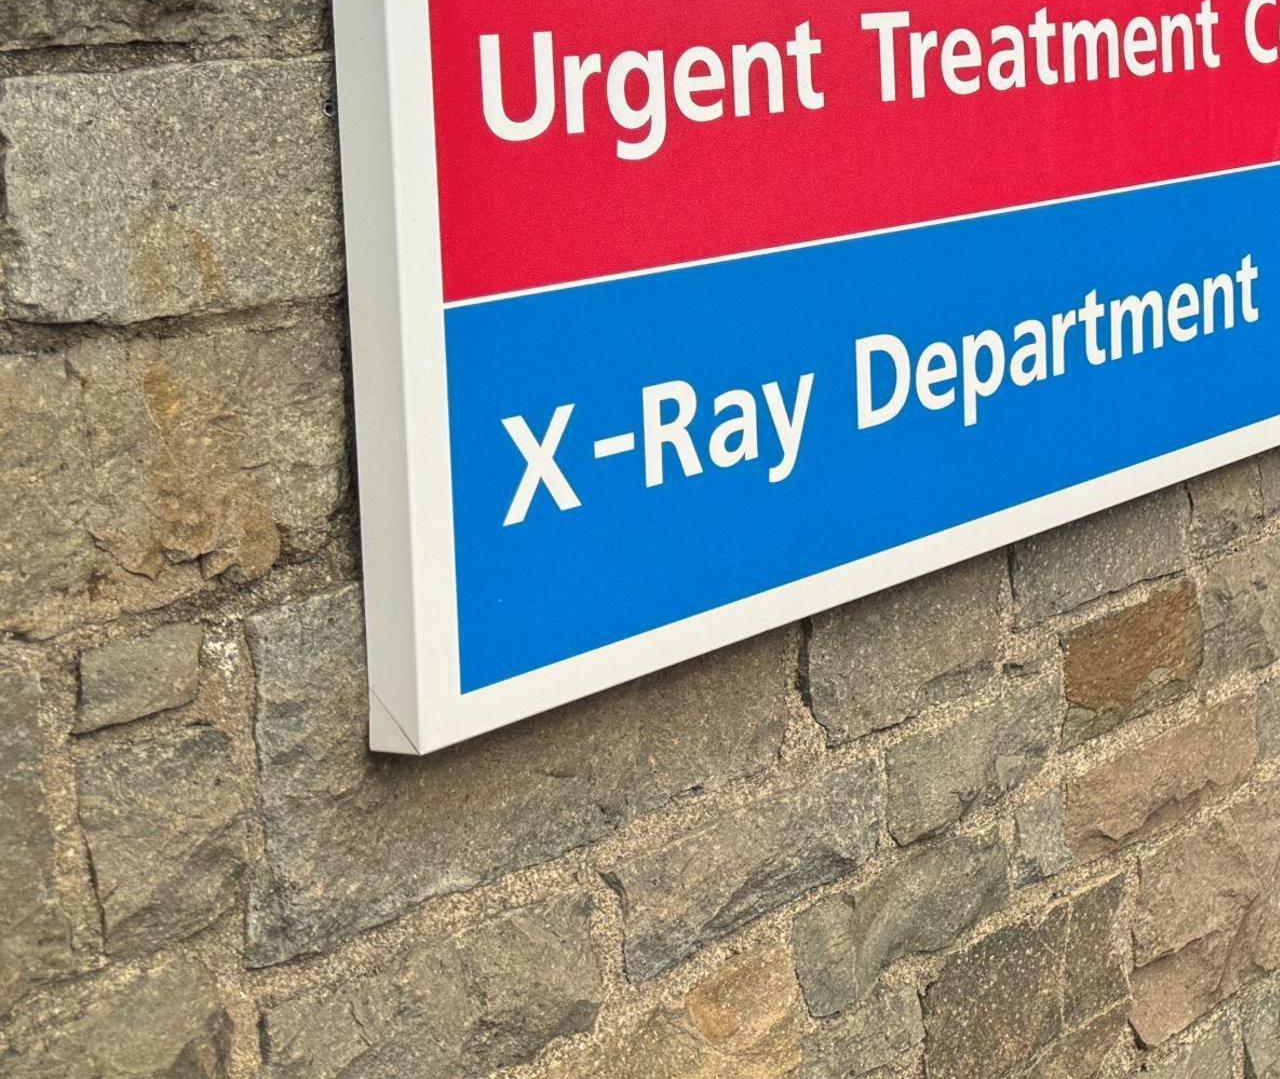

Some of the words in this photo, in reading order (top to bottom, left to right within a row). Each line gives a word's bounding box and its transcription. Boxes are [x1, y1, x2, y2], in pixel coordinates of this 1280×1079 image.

[480, 20, 825, 161] Urgent
[502, 373, 814, 526] X-Ray
[855, 254, 1259, 430] Department
